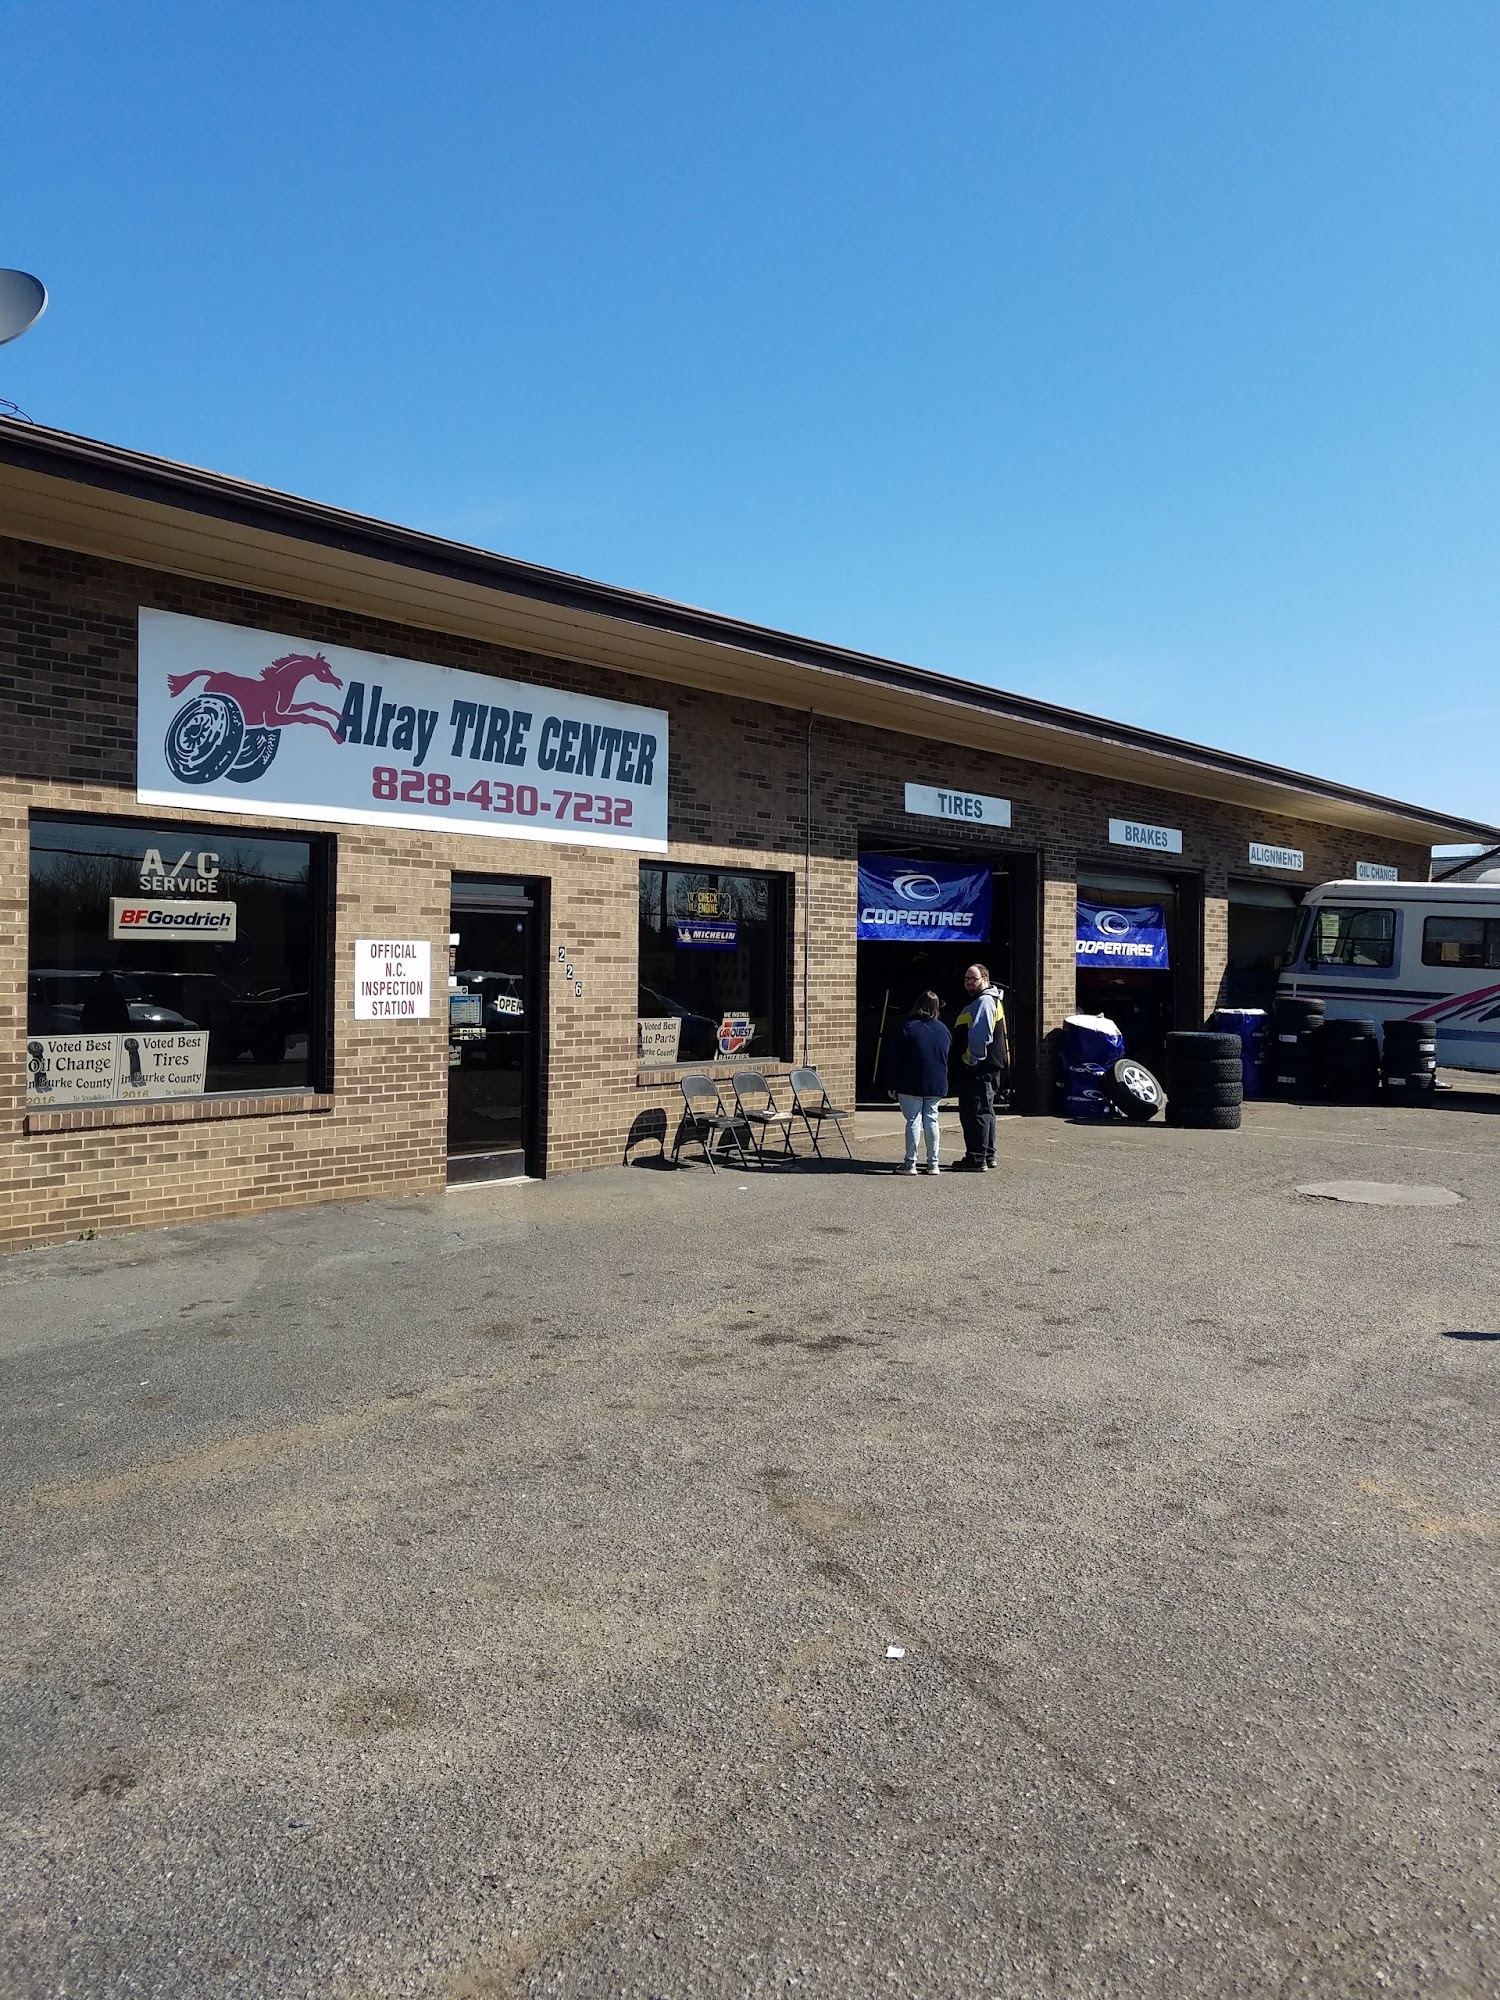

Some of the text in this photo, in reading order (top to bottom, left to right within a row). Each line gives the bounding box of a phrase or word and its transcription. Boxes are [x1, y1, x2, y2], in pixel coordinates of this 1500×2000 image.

[336, 681, 657, 786] Alray TIRE CENTER
[372, 766, 633, 828] 828-430-7232
[938, 793, 983, 819] TIRES
[1124, 825, 1168, 847] BRAKES
[139, 849, 219, 879] A/C
[1250, 846, 1302, 868] ALIGNMENTS
[1359, 864, 1396, 882] OIL CHANGE
[139, 876, 218, 894] SERVICE
[697, 892, 718, 903] CHECK
[697, 902, 719, 914] ENGINE
[120, 909, 231, 926] BFGoodrich
[860, 908, 974, 927] COOPERTIRES
[692, 930, 736, 940] MICHELIN
[370, 943, 417, 959] OFFICIAL
[1075, 940, 1155, 956] OOPERTIRES
[385, 962, 406, 977] N.C.
[361, 980, 423, 996] INSPECTION
[372, 1000, 415, 1016] STATION
[644, 1021, 677, 1031] Voted Best
[48, 1039, 112, 1053] Voted Best
[142, 1036, 202, 1049] Voted Best
[654, 1033, 676, 1044] Parts
[28, 1057, 111, 1073] Oil Change
[153, 1053, 190, 1066] Tires
[38, 1077, 73, 1088] Burke
[76, 1077, 113, 1089] County
[133, 1072, 166, 1082] Burke
[168, 1073, 202, 1084] County
[26, 1095, 56, 1105] 2016
[122, 1089, 149, 1099] 2016
